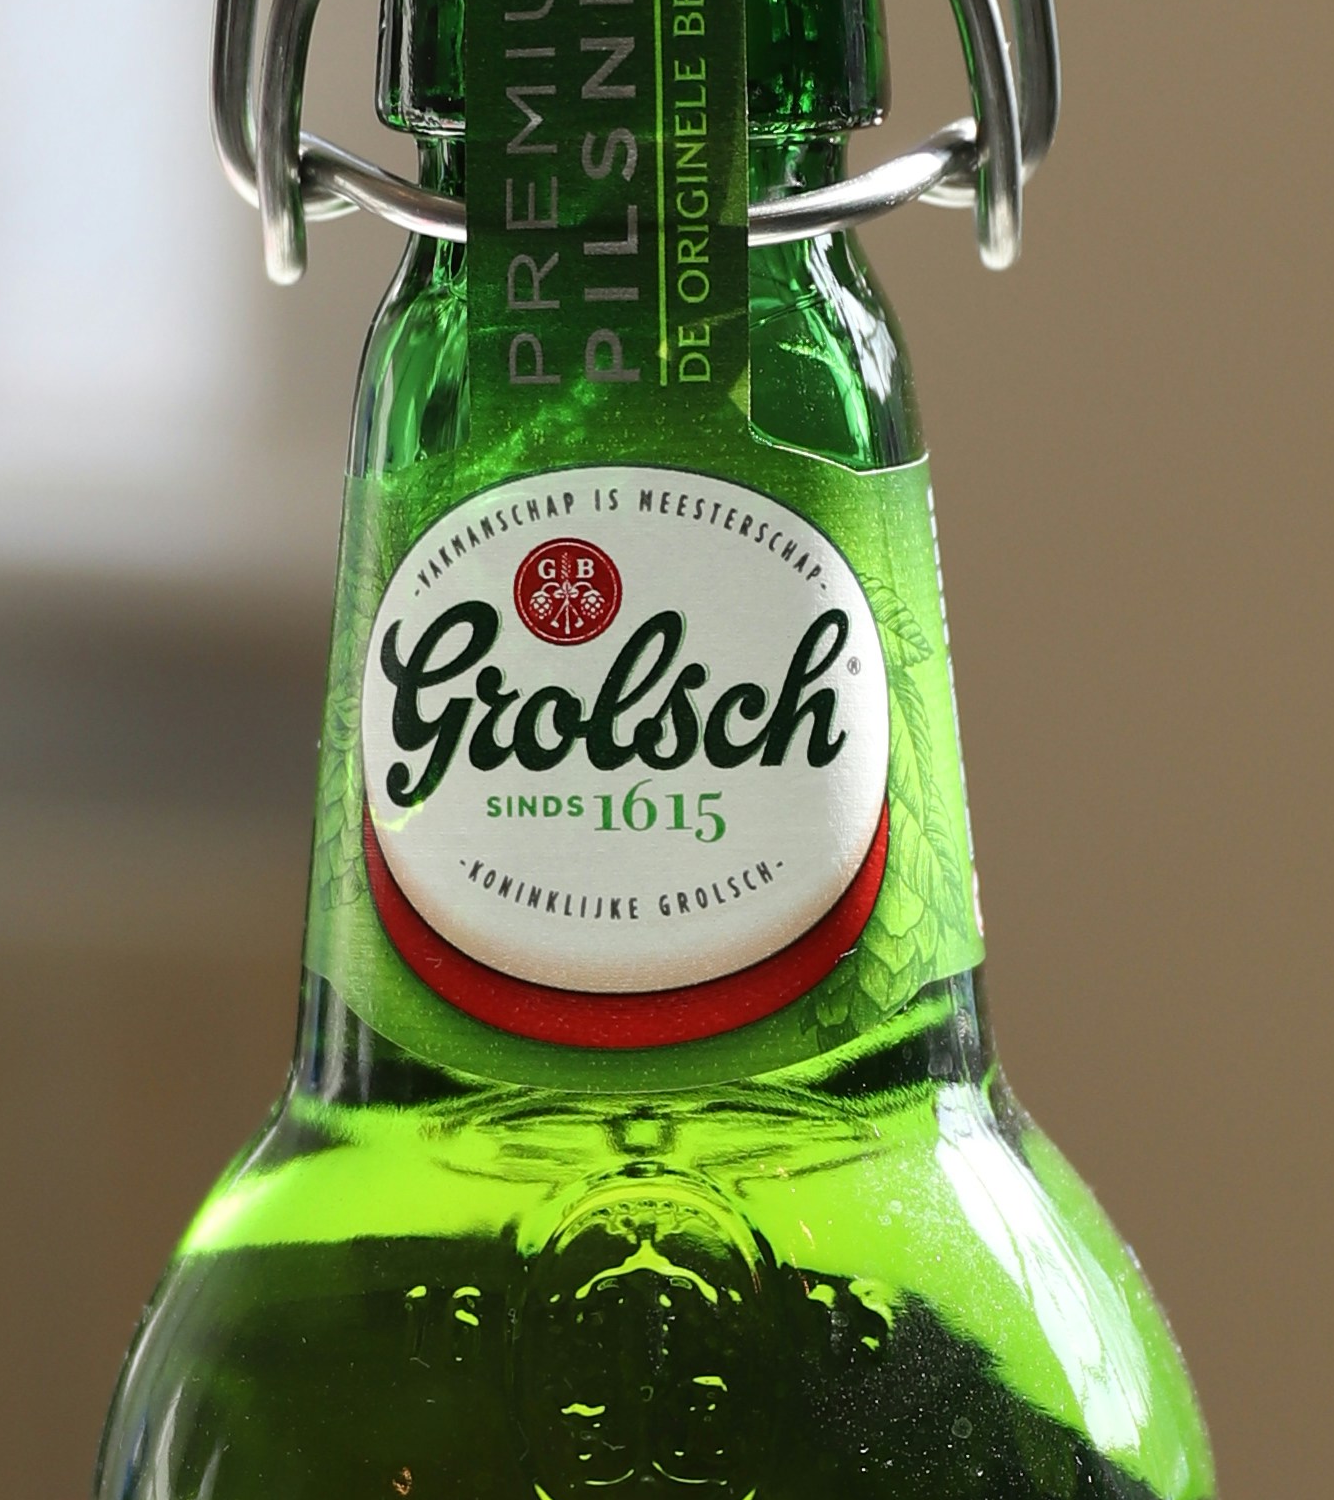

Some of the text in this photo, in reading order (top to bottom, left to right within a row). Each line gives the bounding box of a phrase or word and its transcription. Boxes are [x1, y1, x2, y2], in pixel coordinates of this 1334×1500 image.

[673, 58, 710, 304] ORIGINELE
[677, 325, 711, 384] DE
[594, 488, 619, 512] IS
[379, 599, 851, 809] Grolsch
[486, 778, 726, 843] SINDS 1615
